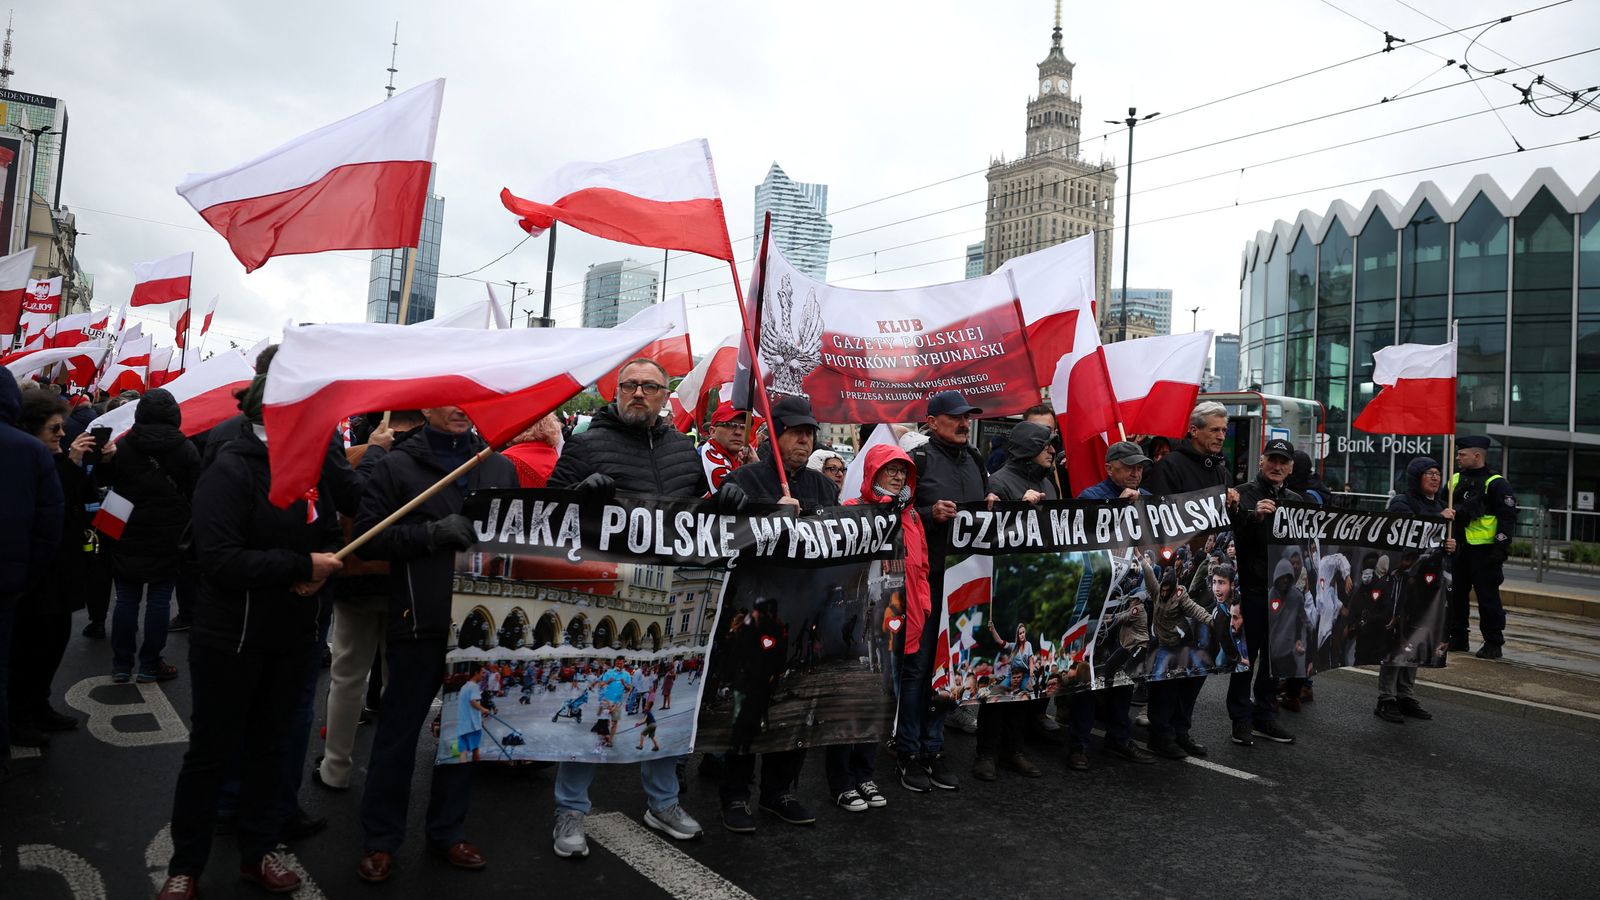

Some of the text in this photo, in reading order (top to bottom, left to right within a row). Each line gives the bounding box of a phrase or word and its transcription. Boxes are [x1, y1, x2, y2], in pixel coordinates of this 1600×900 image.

[832, 326, 984, 351] GAZETY POLSKIEJ
[876, 318, 924, 334] KLUB
[824, 342, 1006, 369] PIOTRKÓW TRYBUNALSKI
[914, 373, 989, 389] KAPUŚCIŃSKIEGO
[846, 391, 884, 401] PREZESA
[884, 391, 923, 401] KLUBÓW
[1337, 435, 1432, 454] Bank Polski
[473, 498, 898, 569] JAKĄ POLSKĘ WYBIERASZ
[952, 508, 1044, 549] CZYJA
[1050, 508, 1088, 546] MA
[1146, 493, 1231, 538] POLSKA
[1272, 506, 1338, 540] CHCESZ
[1333, 513, 1371, 541] ICH
[1367, 516, 1389, 543] U
